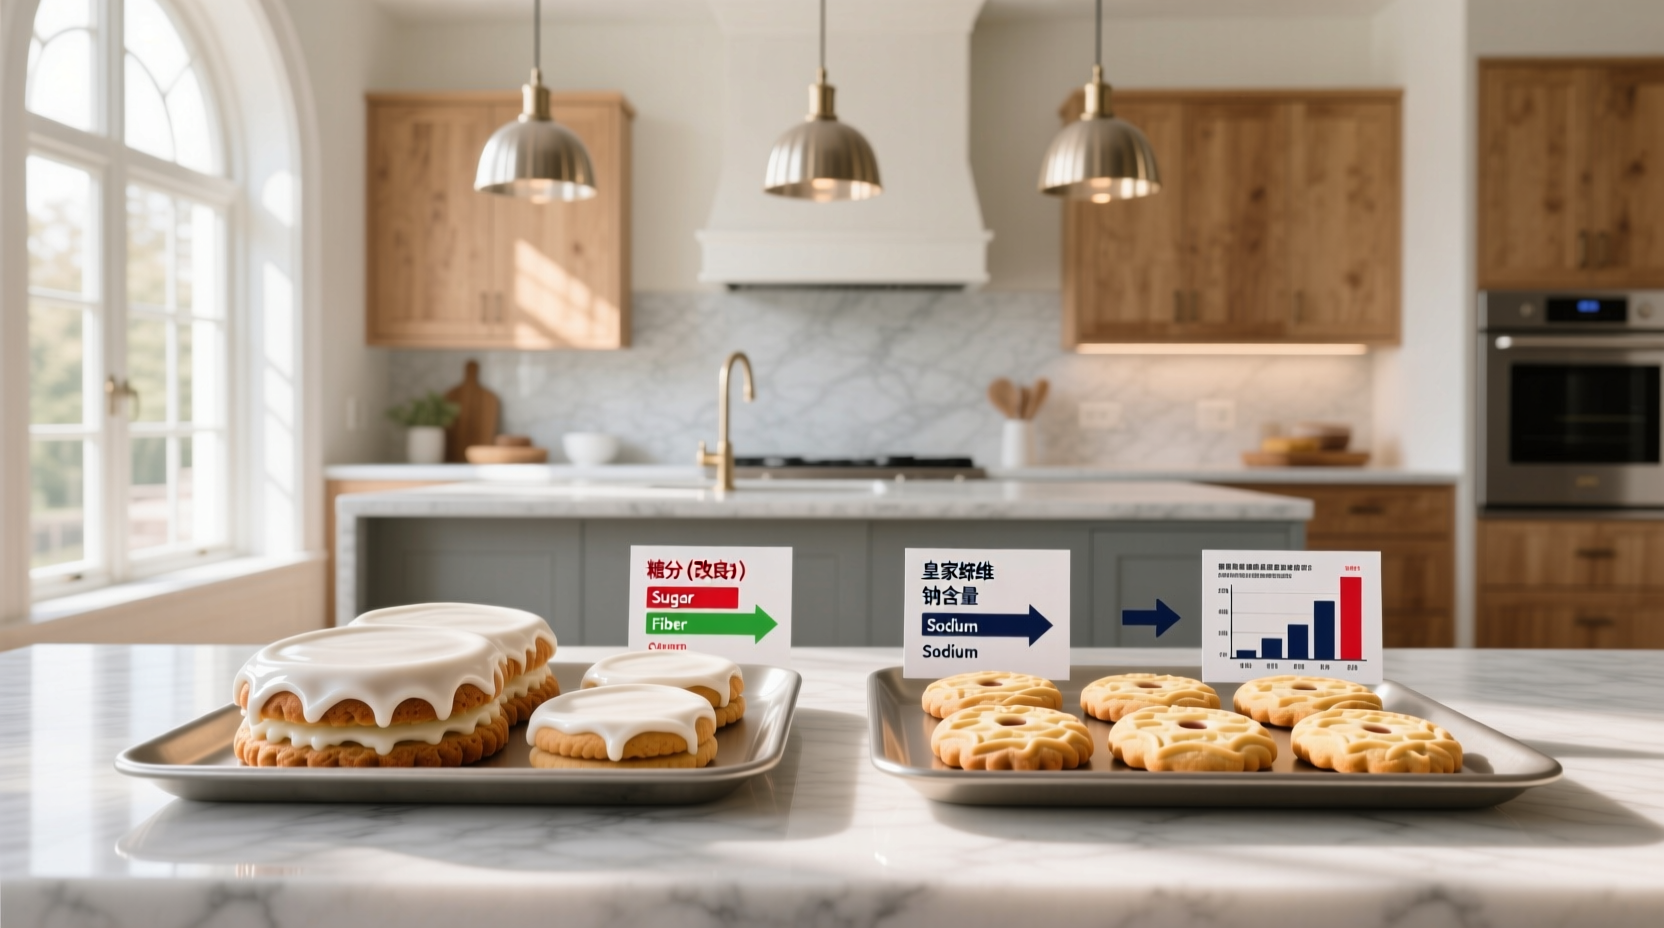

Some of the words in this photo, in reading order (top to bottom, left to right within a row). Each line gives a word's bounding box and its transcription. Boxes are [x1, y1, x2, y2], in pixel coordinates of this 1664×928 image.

[651, 590, 695, 608] Sugar
[652, 617, 688, 631] Fiber
[922, 644, 978, 659] Sodium
